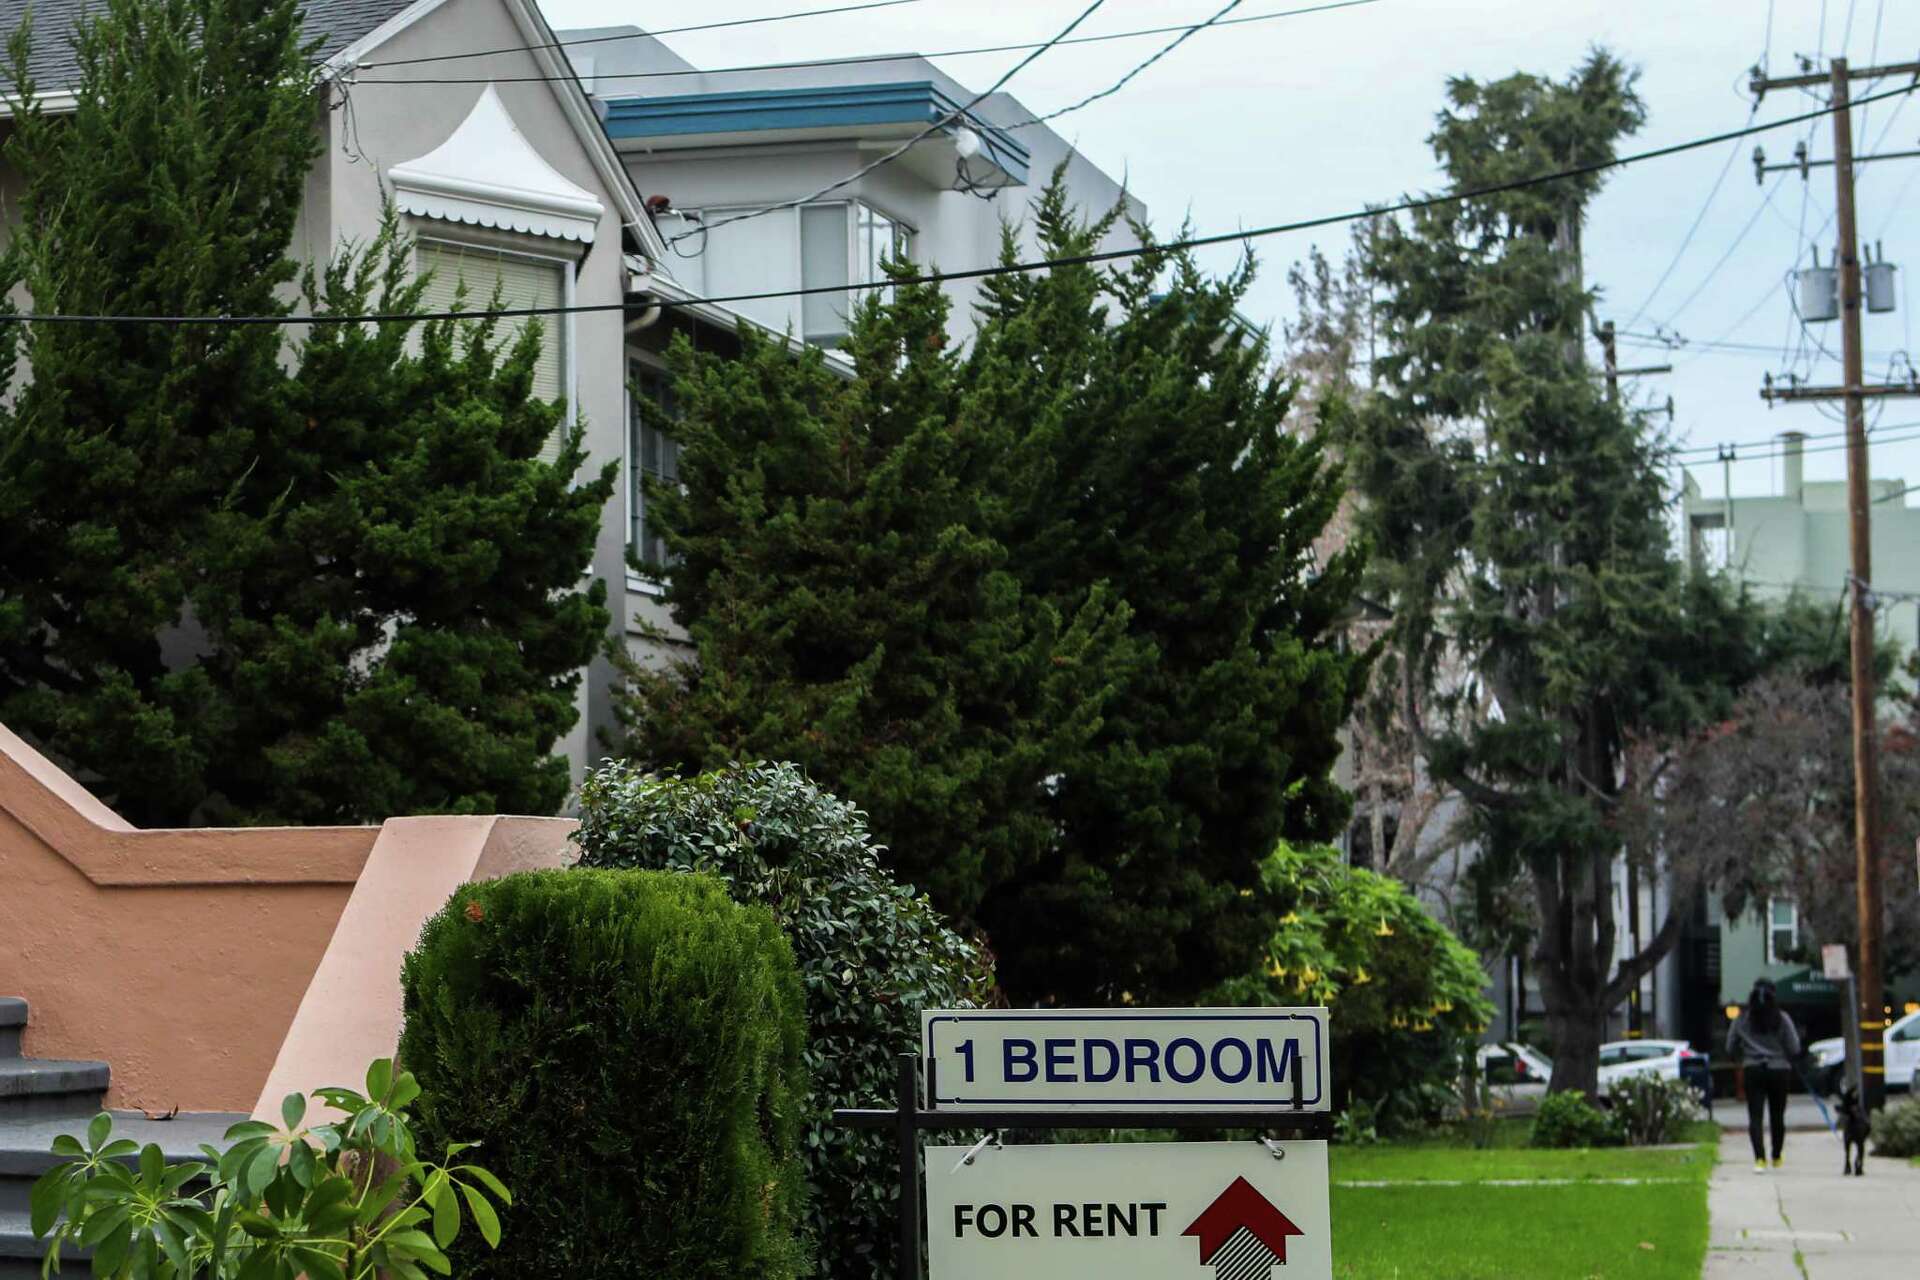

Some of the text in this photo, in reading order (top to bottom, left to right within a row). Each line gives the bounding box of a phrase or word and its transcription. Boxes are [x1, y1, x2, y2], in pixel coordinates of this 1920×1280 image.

[955, 1037, 1300, 1083] 1 BEDROOM
[954, 1203, 1167, 1238] FOR RENT
